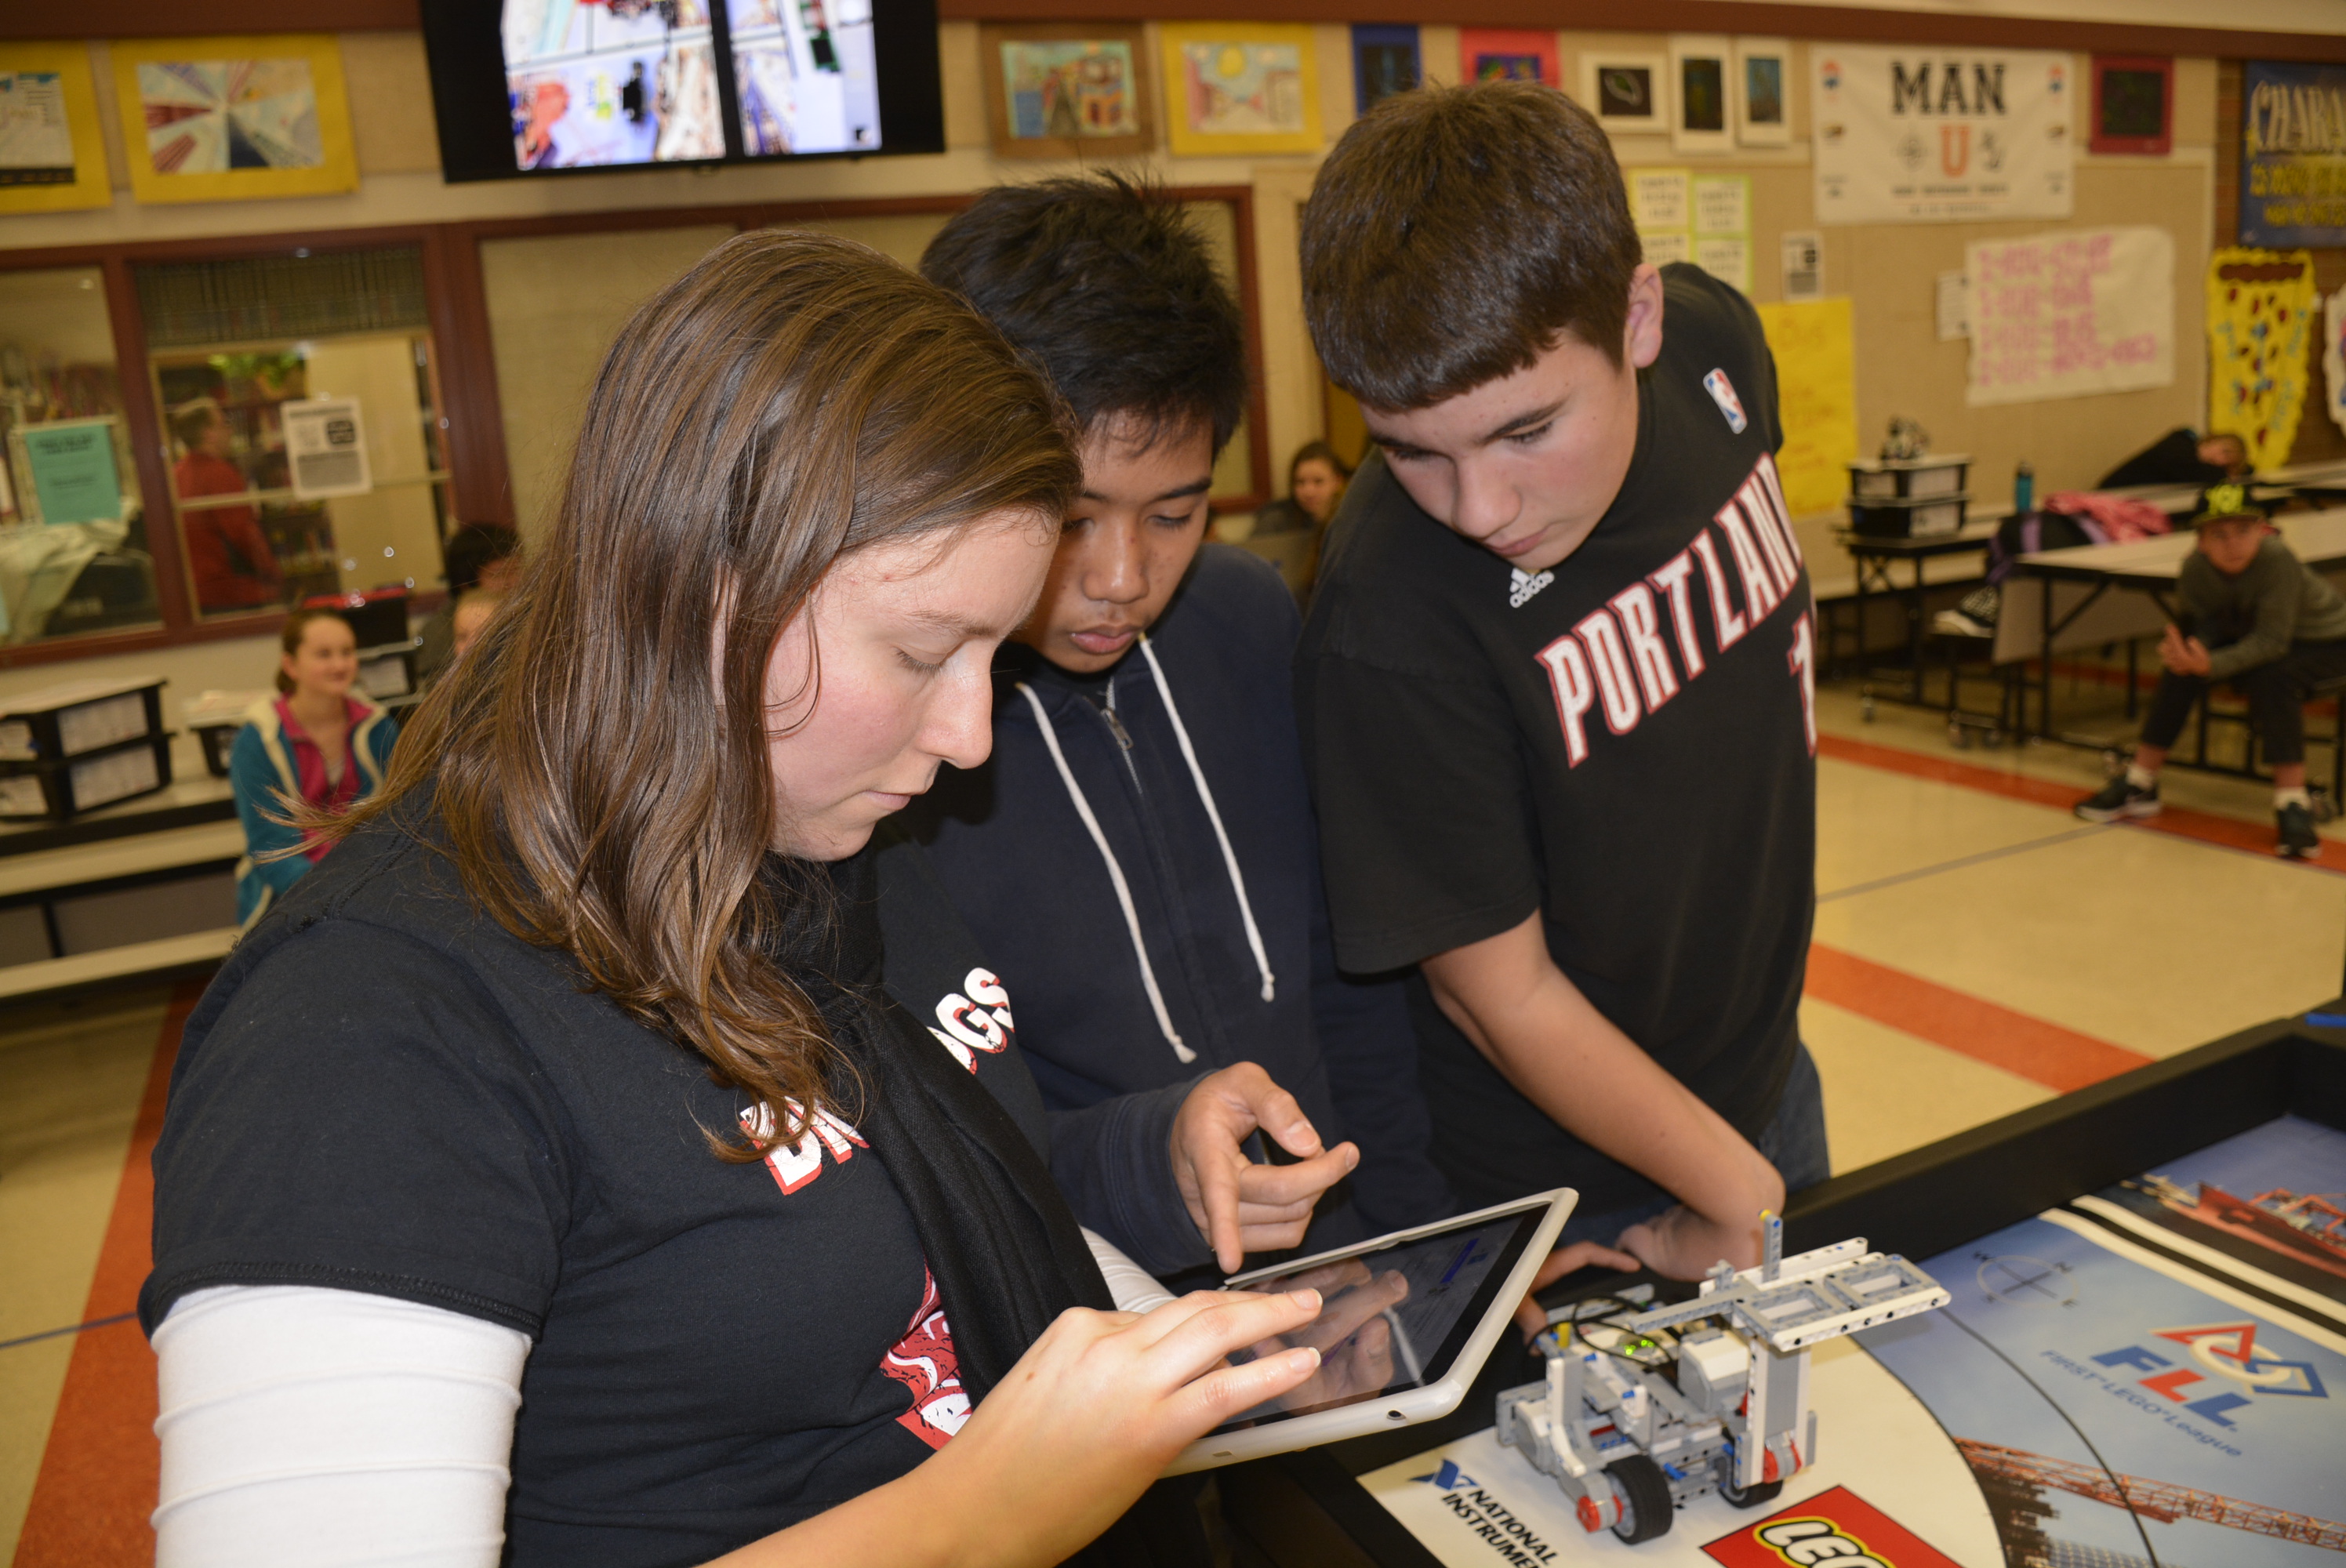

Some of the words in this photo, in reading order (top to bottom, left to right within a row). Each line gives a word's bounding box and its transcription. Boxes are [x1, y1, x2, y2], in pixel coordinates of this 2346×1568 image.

[1891, 61, 2006, 116] MAN
[1938, 124, 1972, 179] U
[1509, 570, 1555, 608] adidas
[1787, 596, 1818, 758] 1
[2090, 1345, 2253, 1428] FLL
[1441, 1493, 1540, 1568] INSTRUME
[1469, 1490, 1559, 1566] NATIONAL
